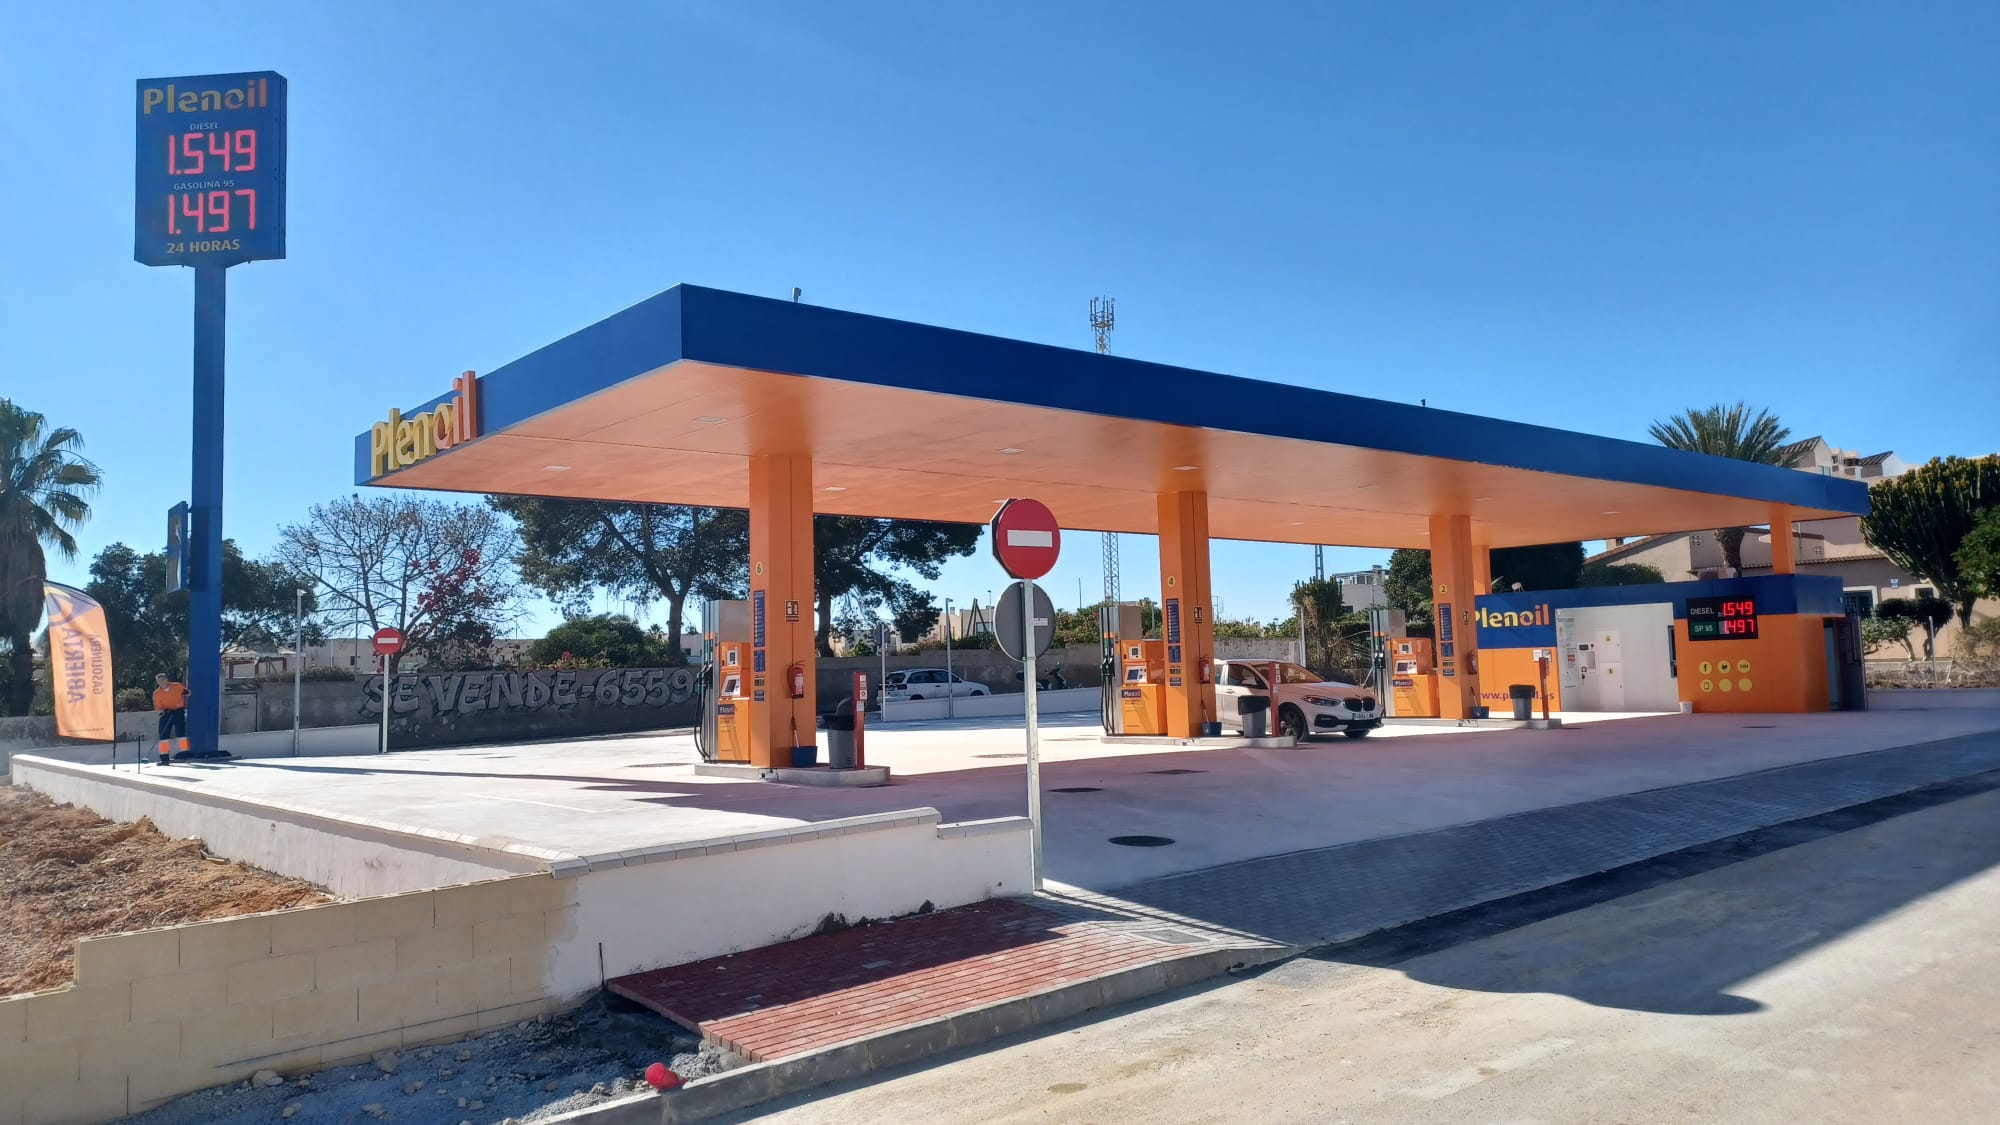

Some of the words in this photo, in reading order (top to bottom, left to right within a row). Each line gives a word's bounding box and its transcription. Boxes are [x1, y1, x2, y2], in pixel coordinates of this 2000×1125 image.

[143, 78, 267, 115] Plenoil
[189, 121, 219, 131] DIESEL
[168, 129, 256, 176] 1.549
[173, 180, 221, 191] GASOLINA
[223, 179, 235, 188] 95
[168, 189, 256, 235] 1.497
[167, 242, 185, 254] 24
[189, 239, 240, 253] HORAS
[371, 371, 476, 477] Plenoil
[1690, 607, 1715, 615] DIESEL
[1705, 624, 1713, 632] 95
[361, 671, 419, 717] SE
